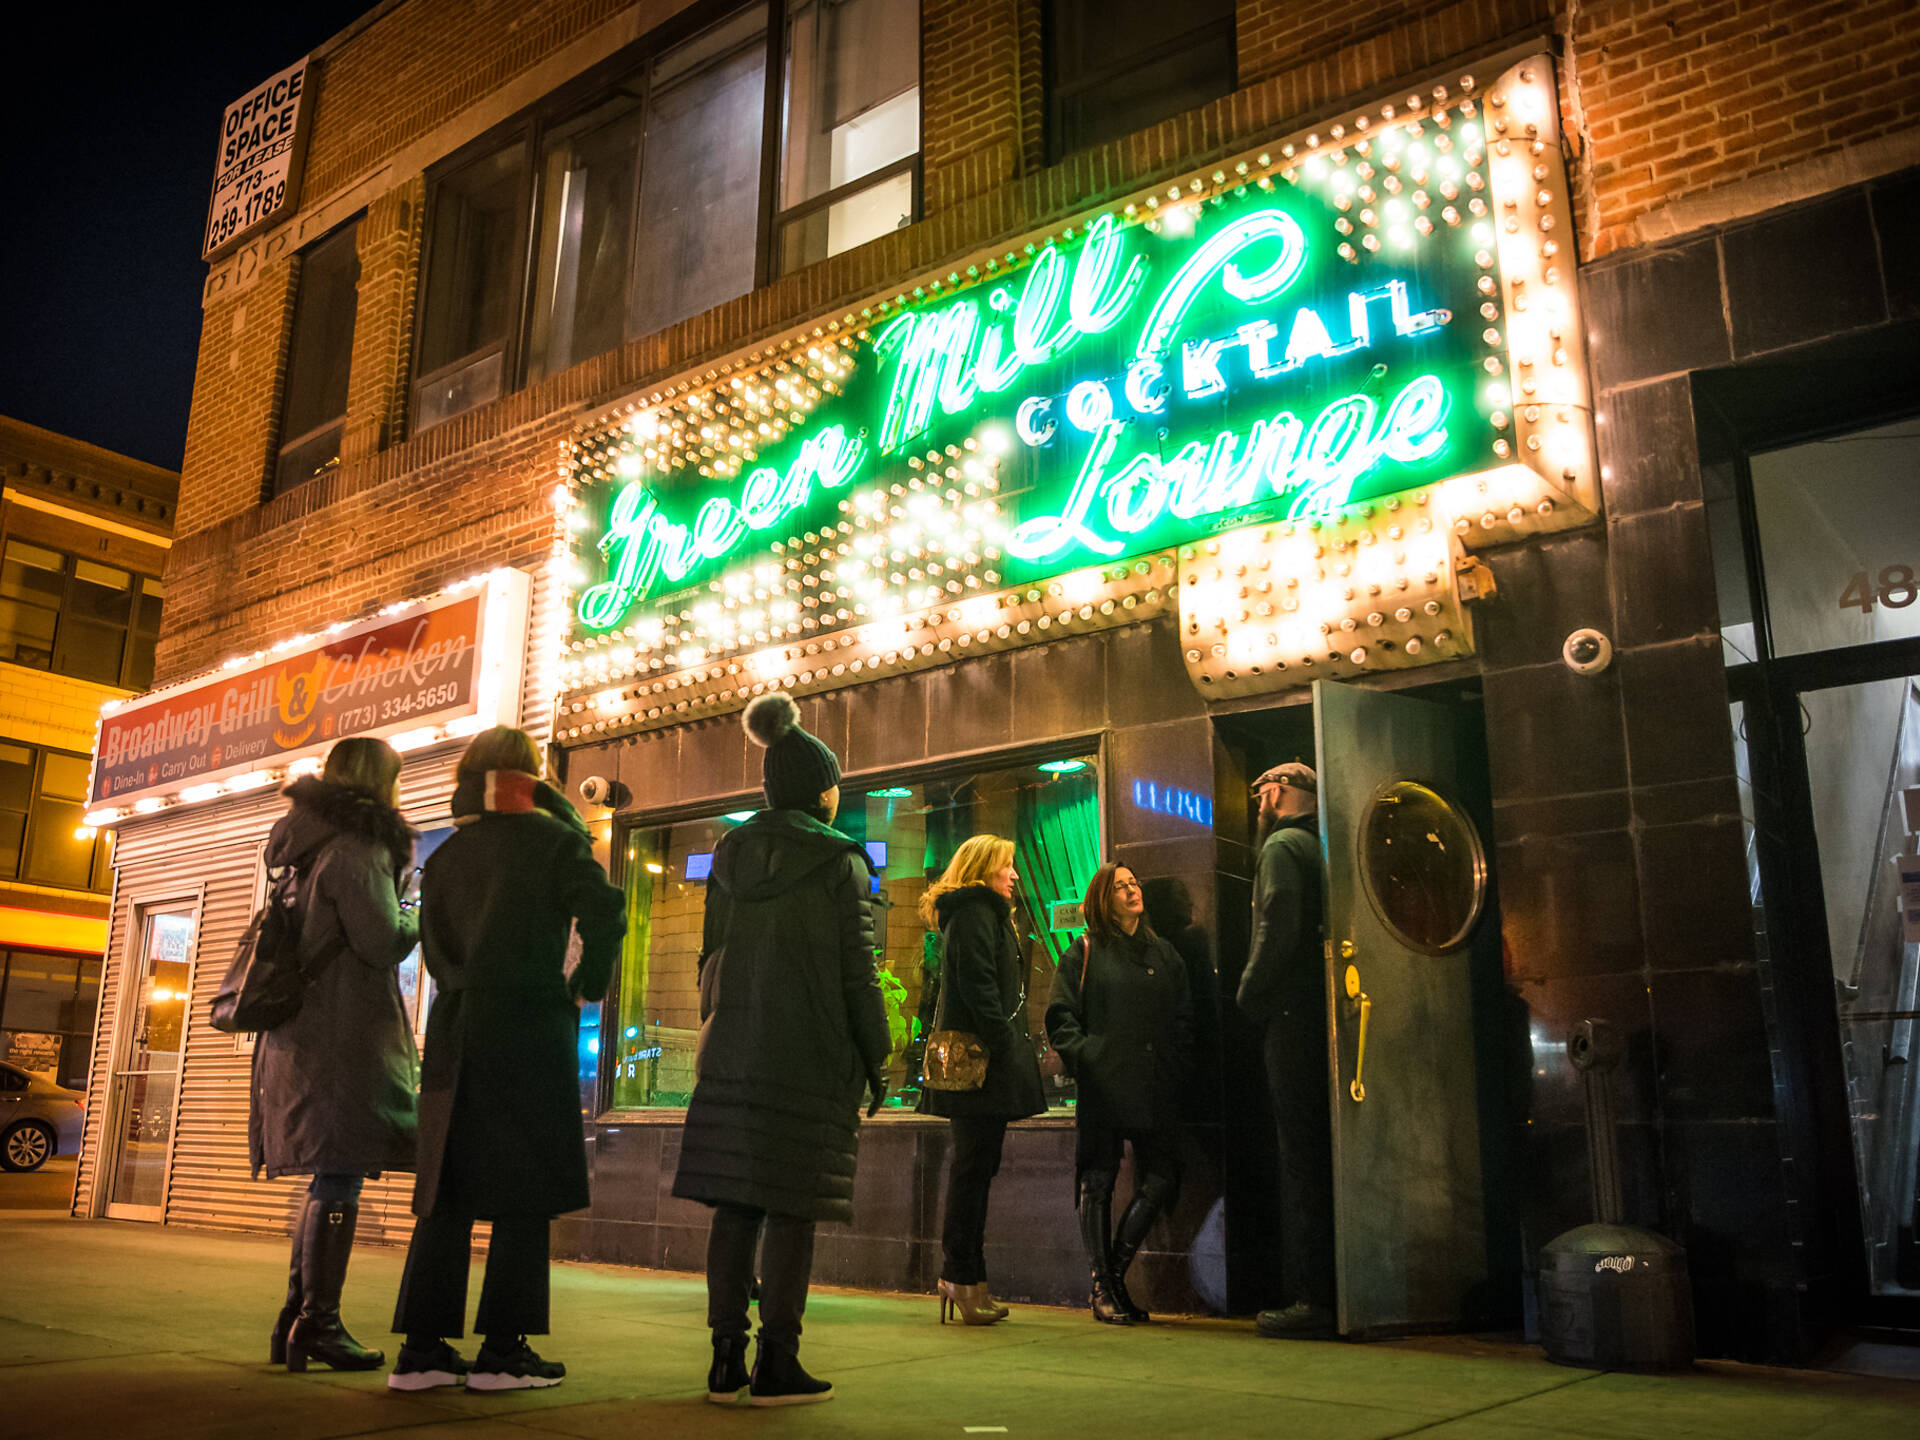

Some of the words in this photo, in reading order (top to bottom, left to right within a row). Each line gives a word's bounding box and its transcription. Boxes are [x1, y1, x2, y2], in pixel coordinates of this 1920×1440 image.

[224, 104, 295, 168] SPACE
[226, 69, 304, 138] OFFICE
[216, 163, 242, 193] FOR
[244, 137, 294, 174] LEASE
[209, 180, 286, 250] 259-1789
[1015, 278, 1452, 447] COCKTAIL
[577, 424, 870, 630] Green
[873, 211, 1148, 457] Mill
[1004, 372, 1452, 565] Lounge
[105, 702, 216, 768] Broadway
[220, 675, 275, 735] Grill
[288, 676, 307, 717] &
[323, 618, 466, 704] Chicken
[337, 703, 378, 736] (773)
[381, 681, 459, 720] 334-5650
[114, 771, 145, 791] Dine-In
[161, 758, 187, 779] Carry
[189, 752, 207, 770] Out
[225, 737, 268, 761] Delivery
